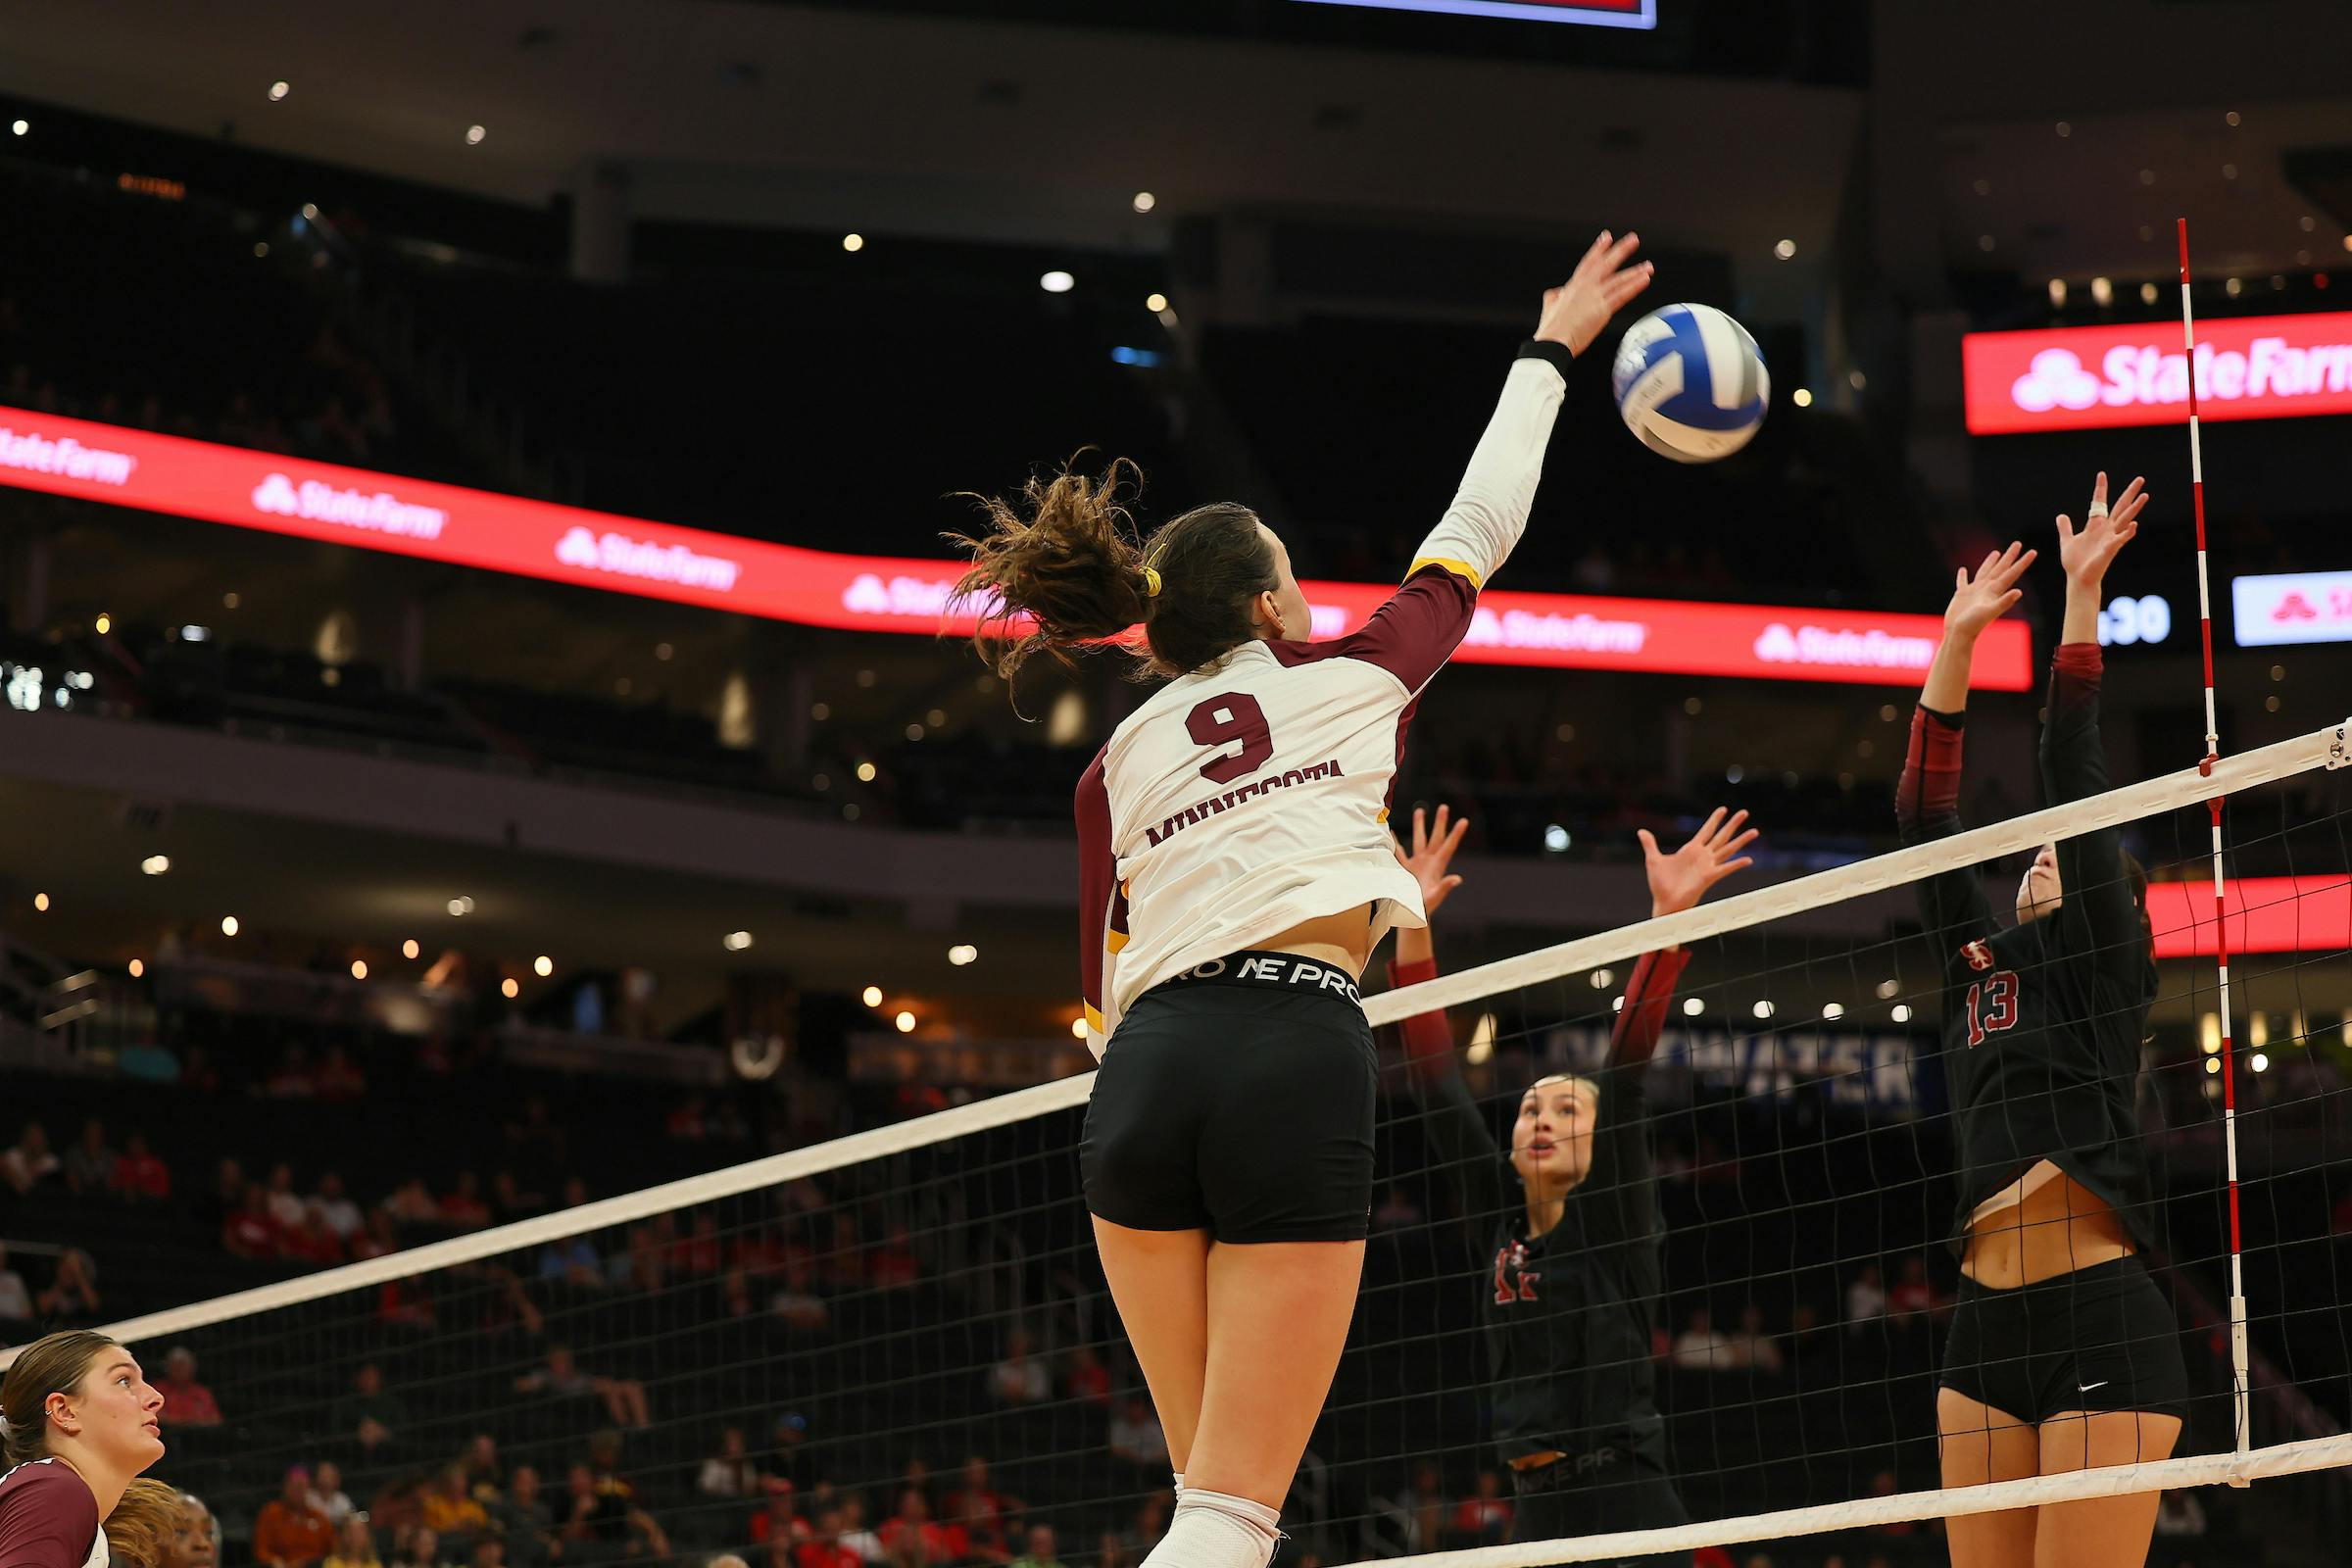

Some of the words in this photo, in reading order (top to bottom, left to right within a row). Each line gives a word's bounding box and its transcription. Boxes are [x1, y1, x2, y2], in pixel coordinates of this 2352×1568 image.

[1184, 691, 1274, 785] 9
[1289, 962, 1363, 1009] PRO
[1965, 969, 2020, 1050] 13
